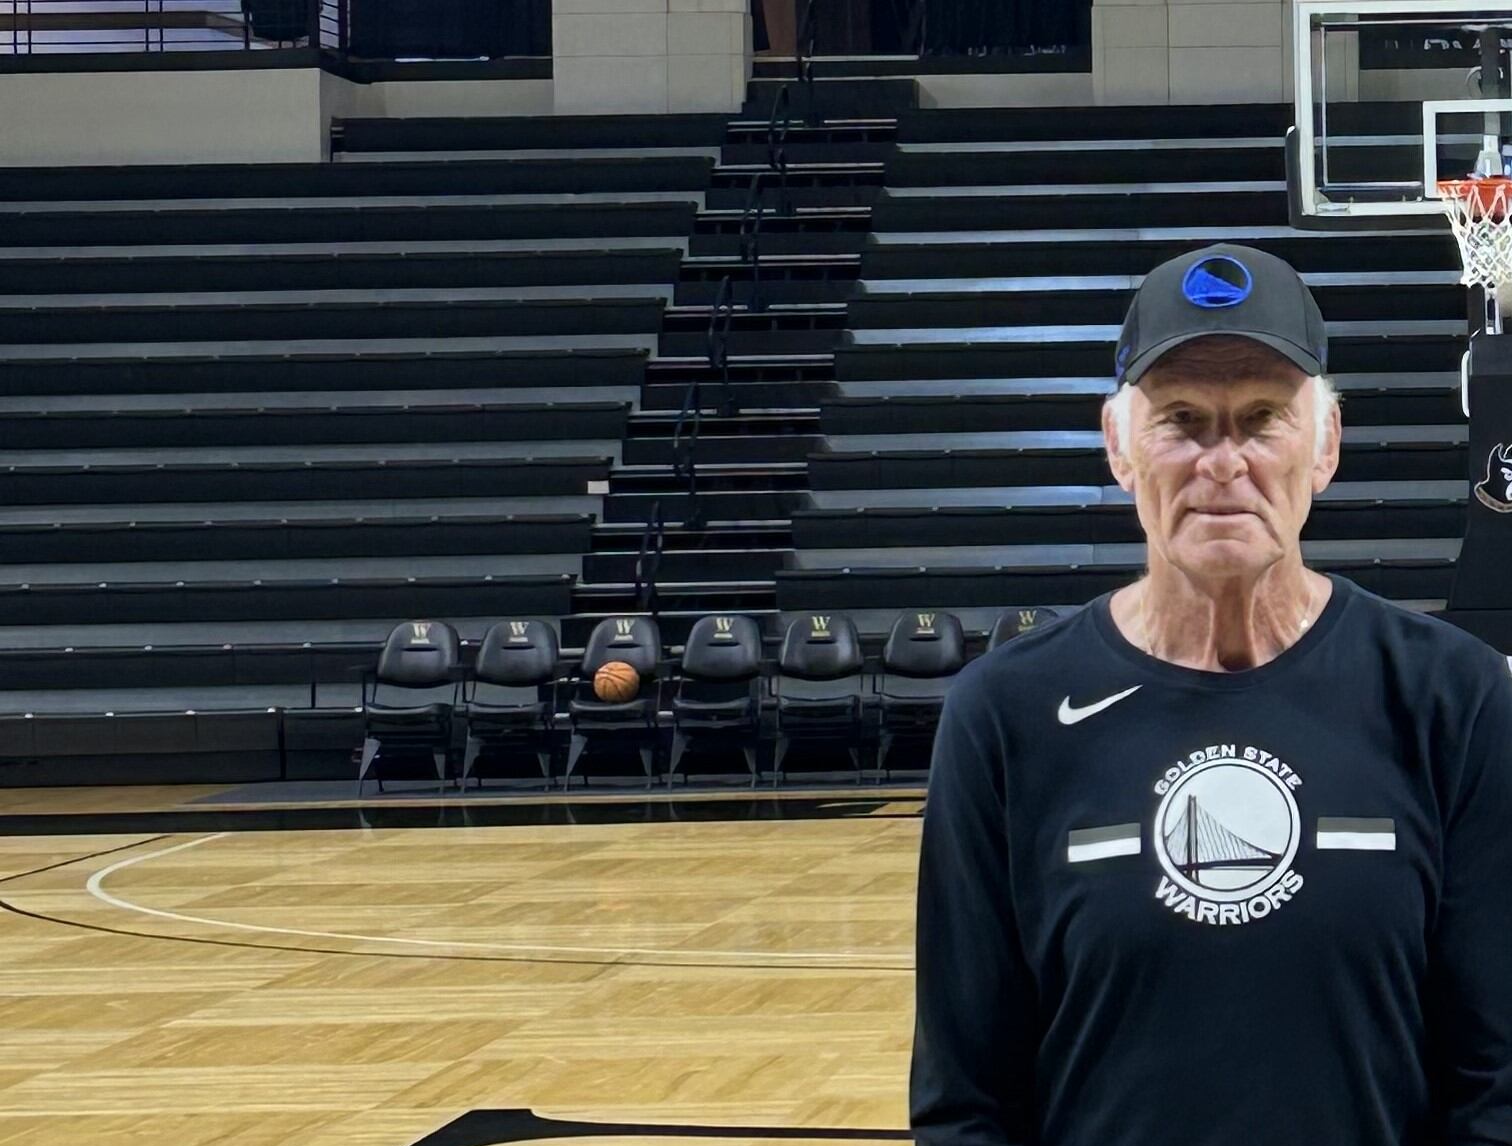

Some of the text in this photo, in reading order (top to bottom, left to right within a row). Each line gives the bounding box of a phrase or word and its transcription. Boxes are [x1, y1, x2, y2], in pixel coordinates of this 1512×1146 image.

[812, 616, 831, 630] W
[918, 613, 935, 627] W
[1154, 744, 1303, 797] GOLDEN STATE
[1154, 869, 1304, 926] WARRIORS
